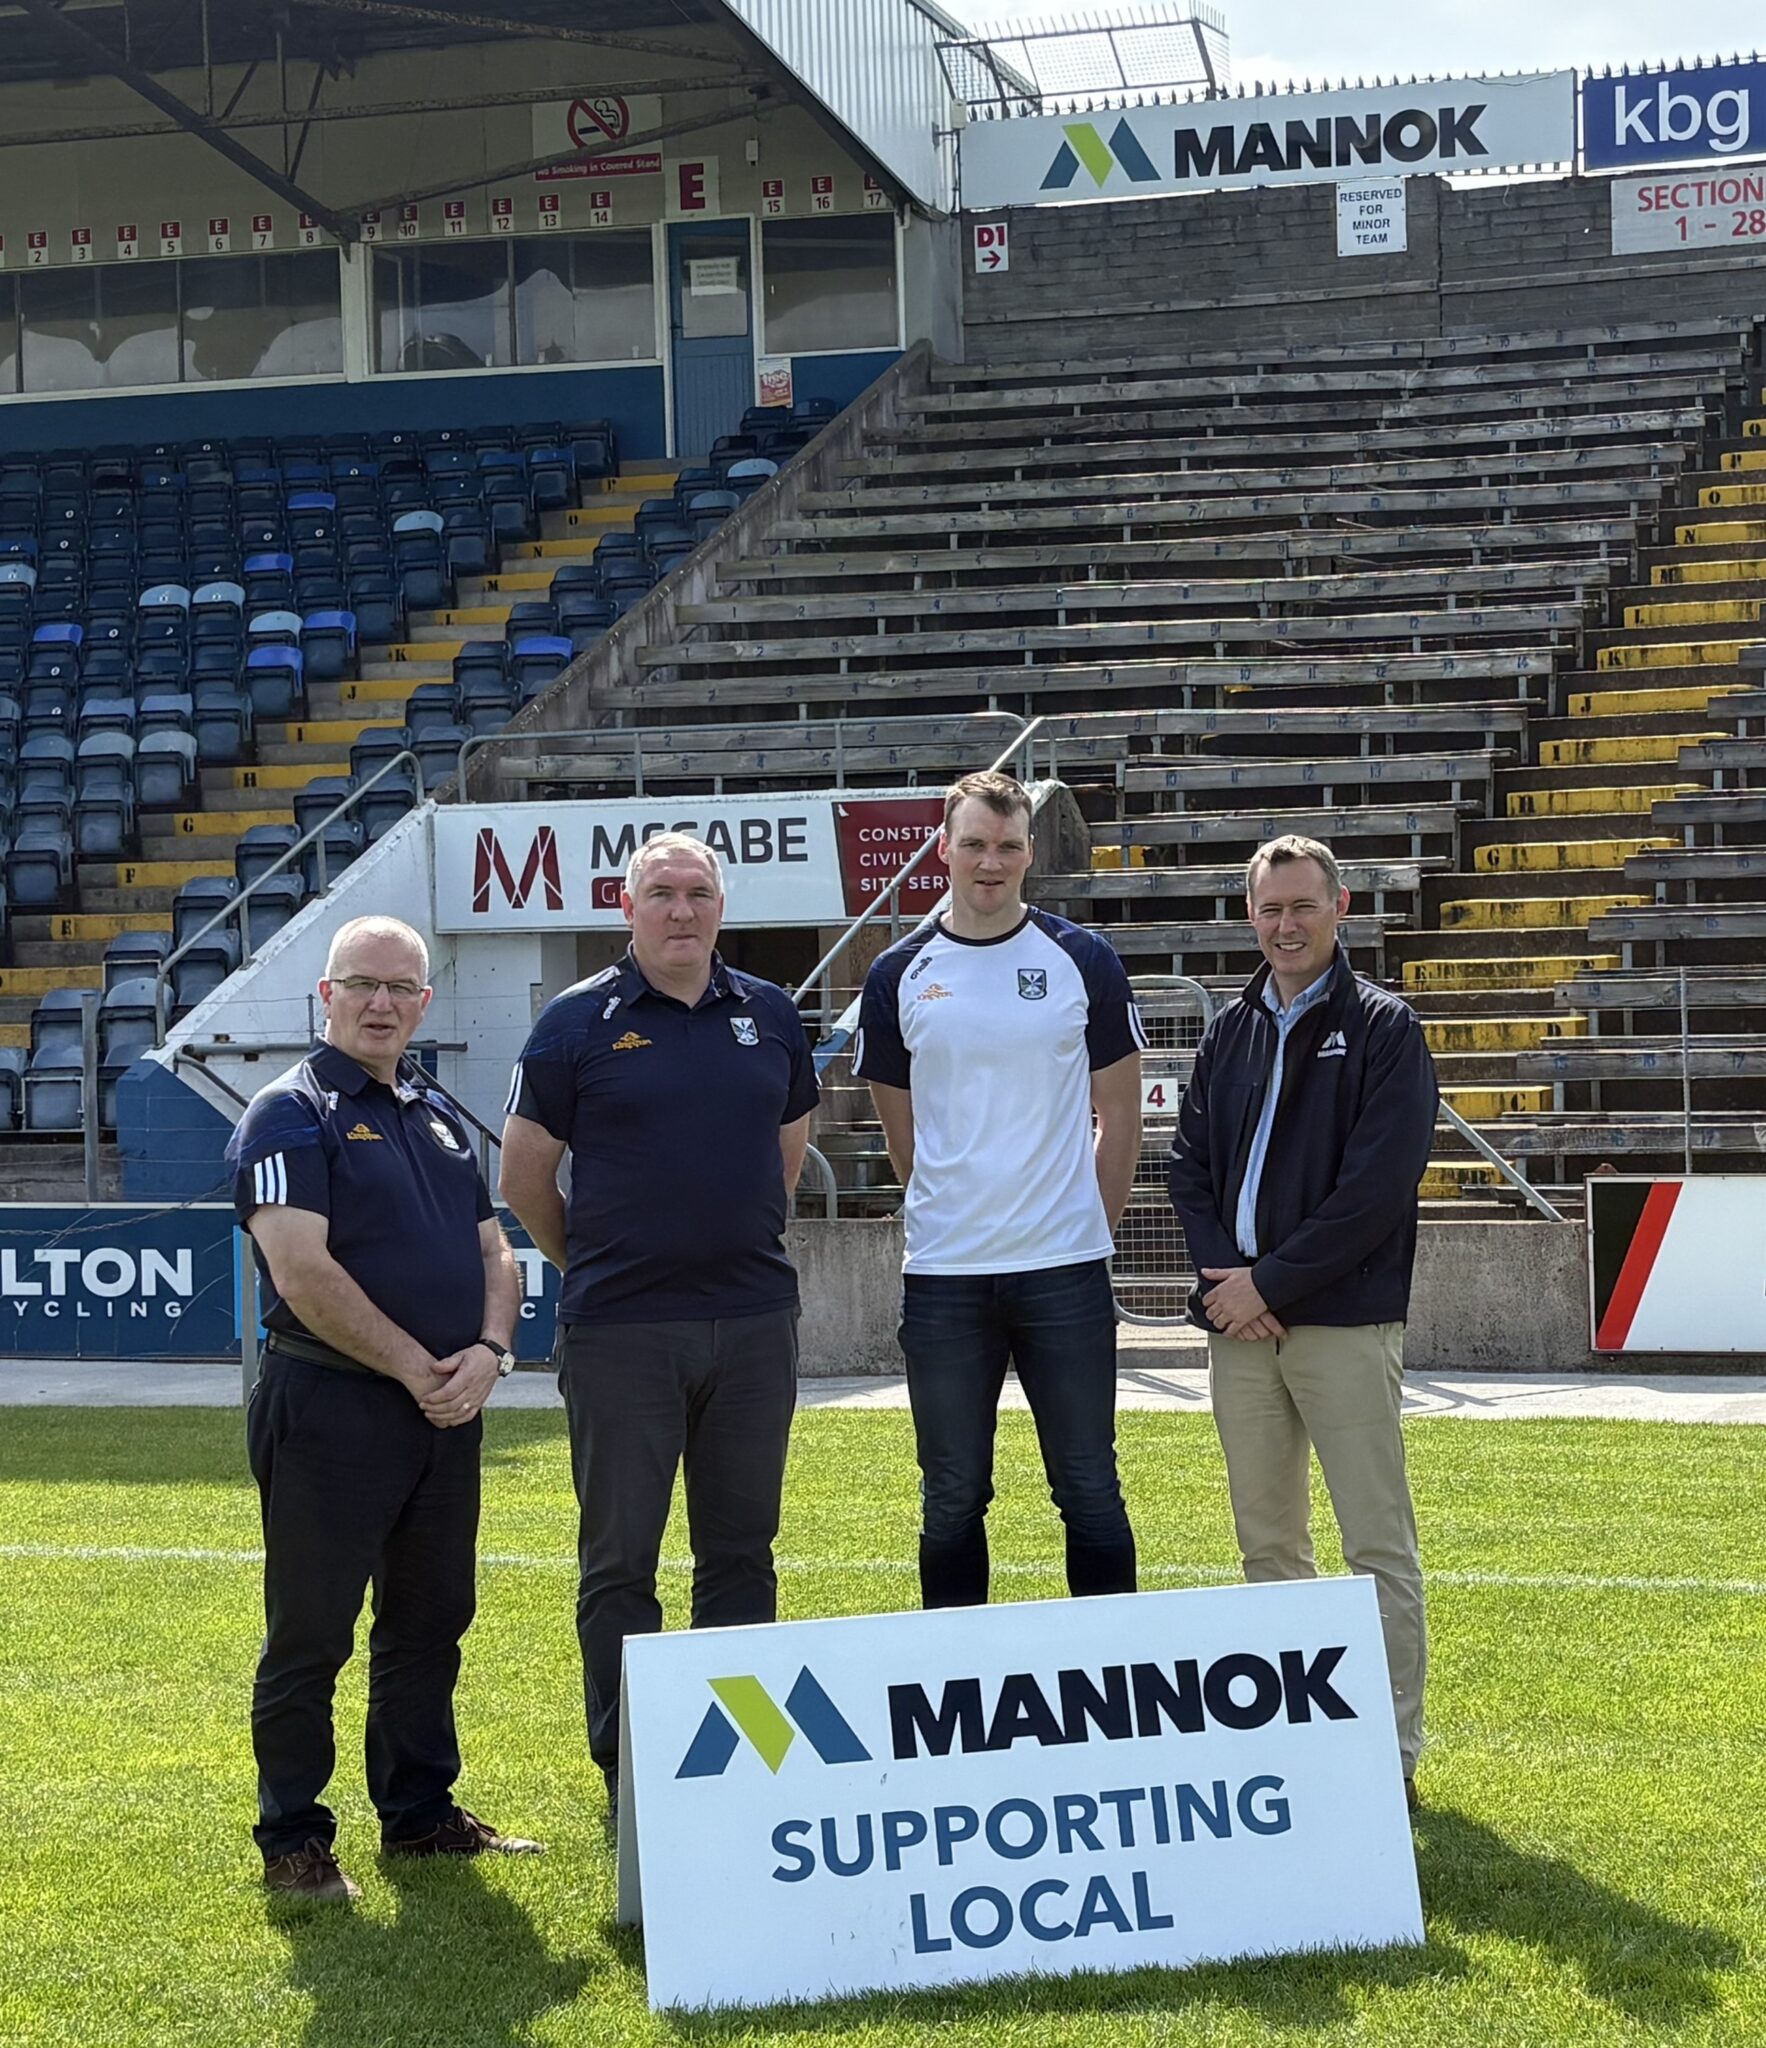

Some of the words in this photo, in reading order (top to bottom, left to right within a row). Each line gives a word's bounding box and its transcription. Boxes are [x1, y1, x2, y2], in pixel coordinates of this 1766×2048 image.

[1615, 81, 1749, 152] kbg
[1175, 105, 1489, 178] MANNOK
[590, 163, 598, 172] in
[679, 163, 705, 210] E
[769, 183, 776, 195] E
[818, 180, 825, 191] E
[597, 195, 604, 205] E
[868, 193, 882, 205] 17
[1340, 188, 1402, 202] RESERVED
[1638, 177, 1763, 212] SECTION
[499, 201, 506, 212] E
[545, 198, 552, 209] E
[767, 202, 780, 213] 15
[816, 197, 830, 209] 16
[404, 207, 411, 218] E
[451, 205, 458, 216] E
[1359, 204, 1382, 216] FOR
[544, 215, 557, 226] 13
[594, 212, 607, 223] 14
[215, 221, 222, 232] E
[259, 218, 265, 229] E
[450, 221, 462, 233] 11
[497, 218, 510, 229] 12
[1353, 219, 1390, 230] MINOR
[1675, 216, 1687, 240] 1
[1732, 209, 1766, 236] 28
[124, 228, 131, 238] E
[167, 225, 174, 236] E
[368, 227, 375, 238] 9
[34, 236, 40, 246] E
[78, 232, 84, 242] E
[259, 235, 266, 246] 7
[306, 232, 313, 243] 8
[978, 226, 1004, 248] D1
[1356, 233, 1388, 244] TEAM
[168, 241, 174, 252] 5
[215, 238, 223, 249] 6
[79, 248, 85, 259] 3
[124, 244, 131, 256] 4
[35, 252, 41, 263] 2
[1684, 529, 1695, 544] N
[534, 546, 543, 558] N
[488, 579, 498, 591] M
[1303, 767, 1314, 780] 12
[243, 772, 256, 787] H
[1264, 824, 1273, 836] 12
[125, 868, 136, 883] F
[1147, 1084, 1165, 1107] 4
[2, 1248, 193, 1297] LTON
[887, 1646, 1359, 1760] MANNOK
[771, 1775, 1292, 1883] SUPPORTING
[909, 1871, 1174, 1954] LOCAL
